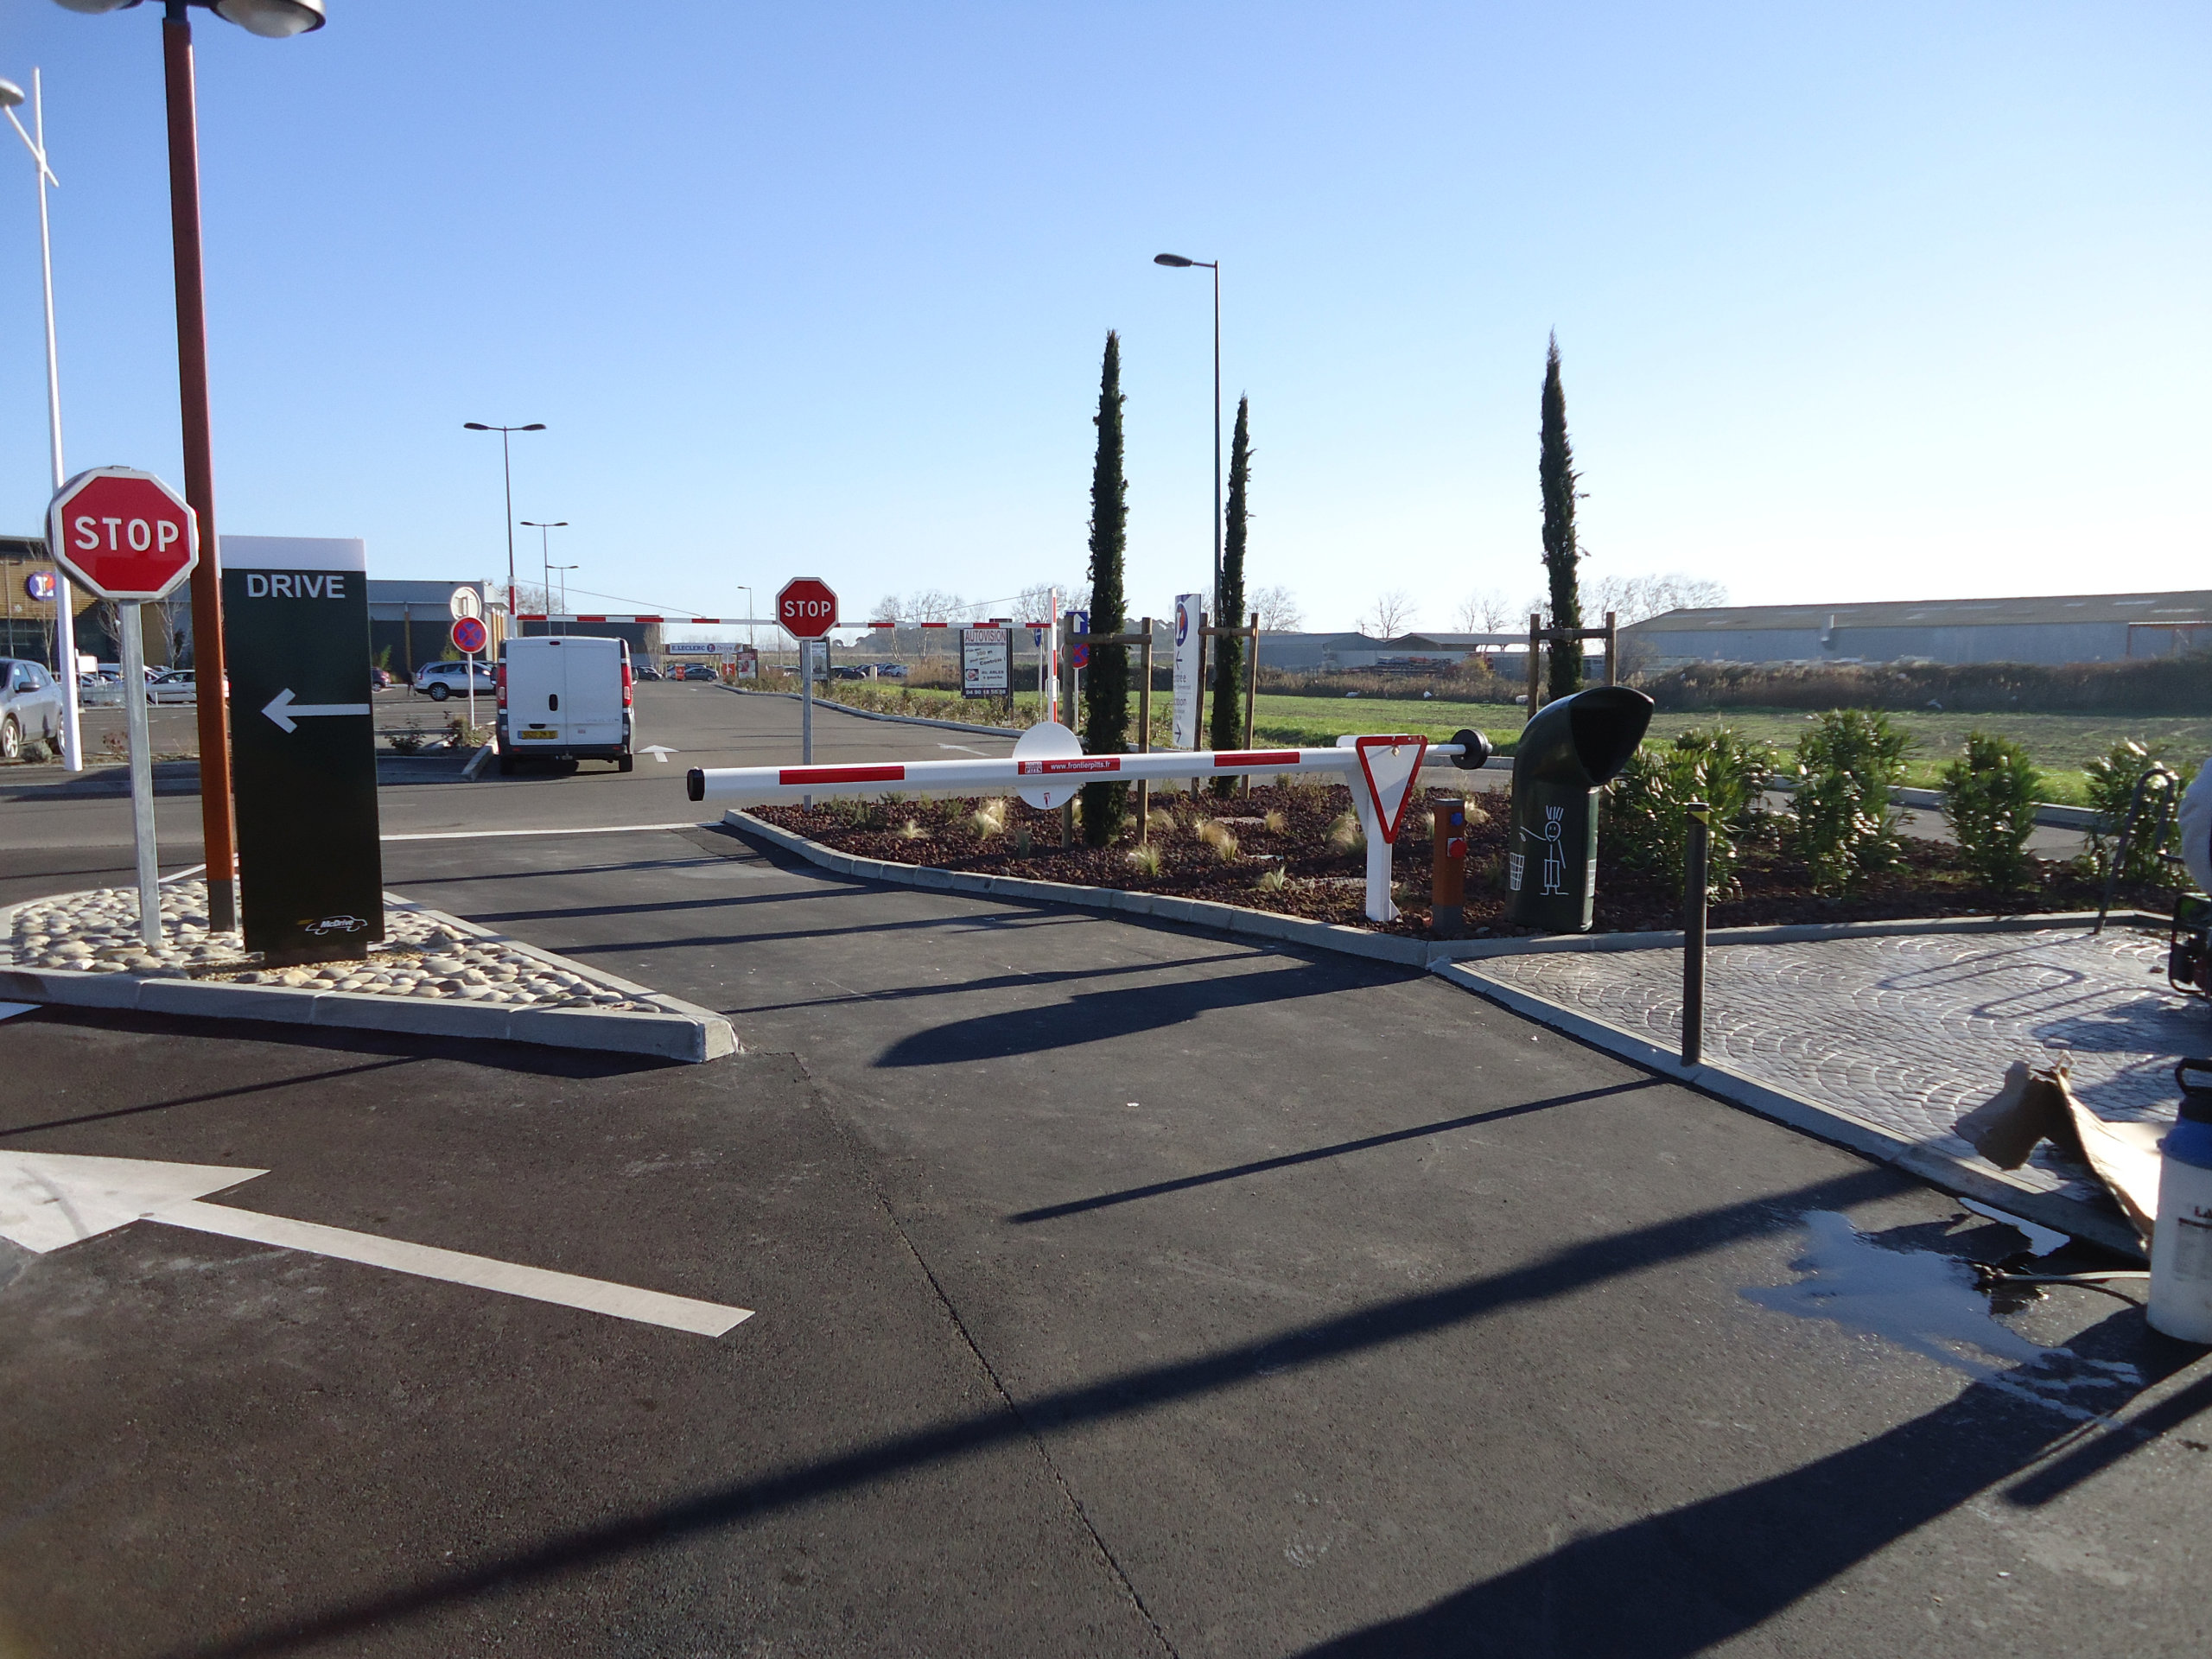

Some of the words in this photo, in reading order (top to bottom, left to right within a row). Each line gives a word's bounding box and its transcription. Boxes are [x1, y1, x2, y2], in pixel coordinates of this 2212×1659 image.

[74, 516, 179, 552] STOP
[247, 574, 346, 598] DRIVE
[784, 600, 831, 617] STOP
[965, 630, 1006, 642] AUTOVISION
[1051, 760, 1110, 772] www.frontierpitts.fr
